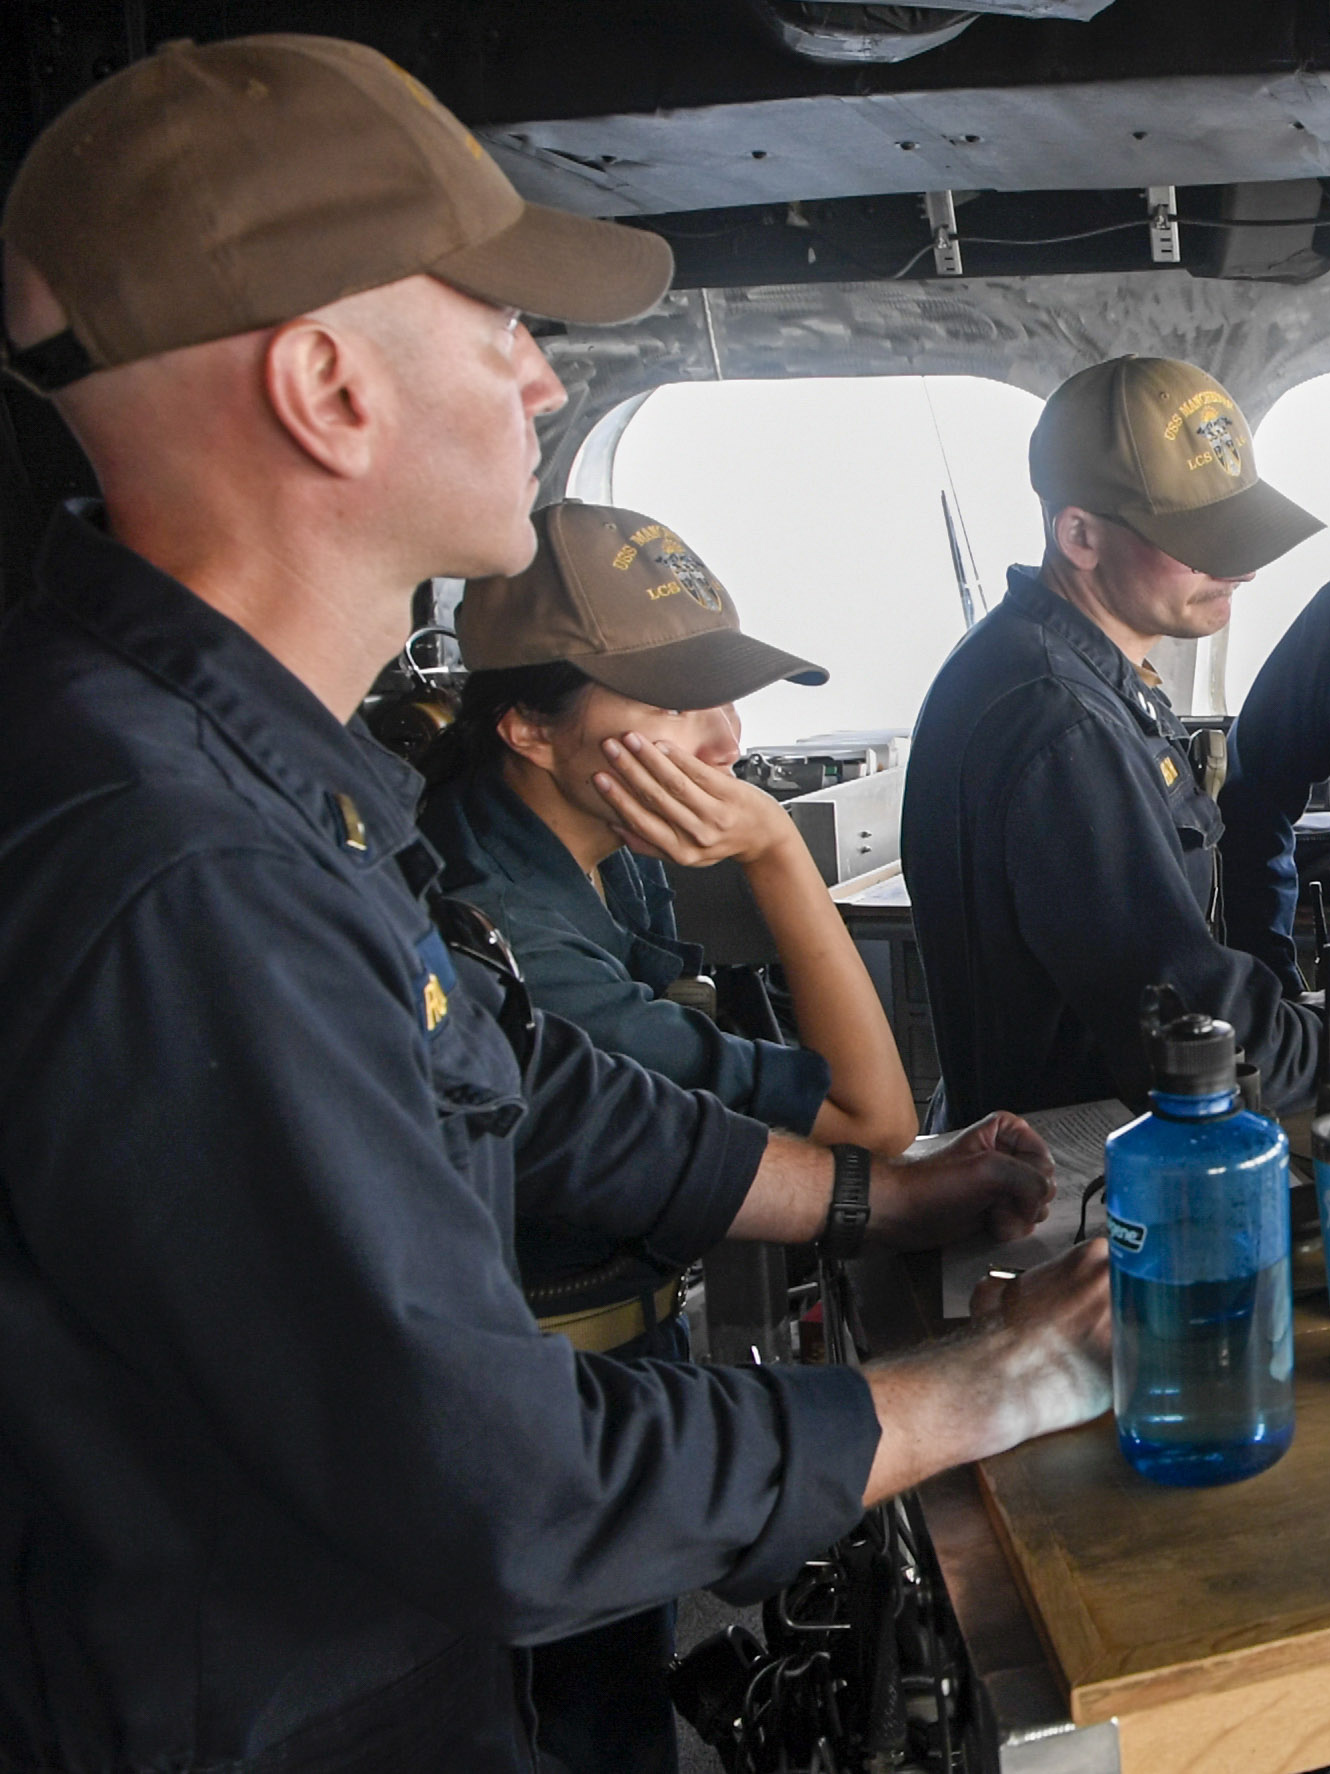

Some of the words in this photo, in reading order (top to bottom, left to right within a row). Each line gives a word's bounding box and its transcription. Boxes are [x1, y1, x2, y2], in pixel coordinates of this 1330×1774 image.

[1164, 413, 1183, 440] USS
[1187, 452, 1213, 470] LCS
[613, 544, 638, 571] USS
[646, 581, 681, 600] LCS
